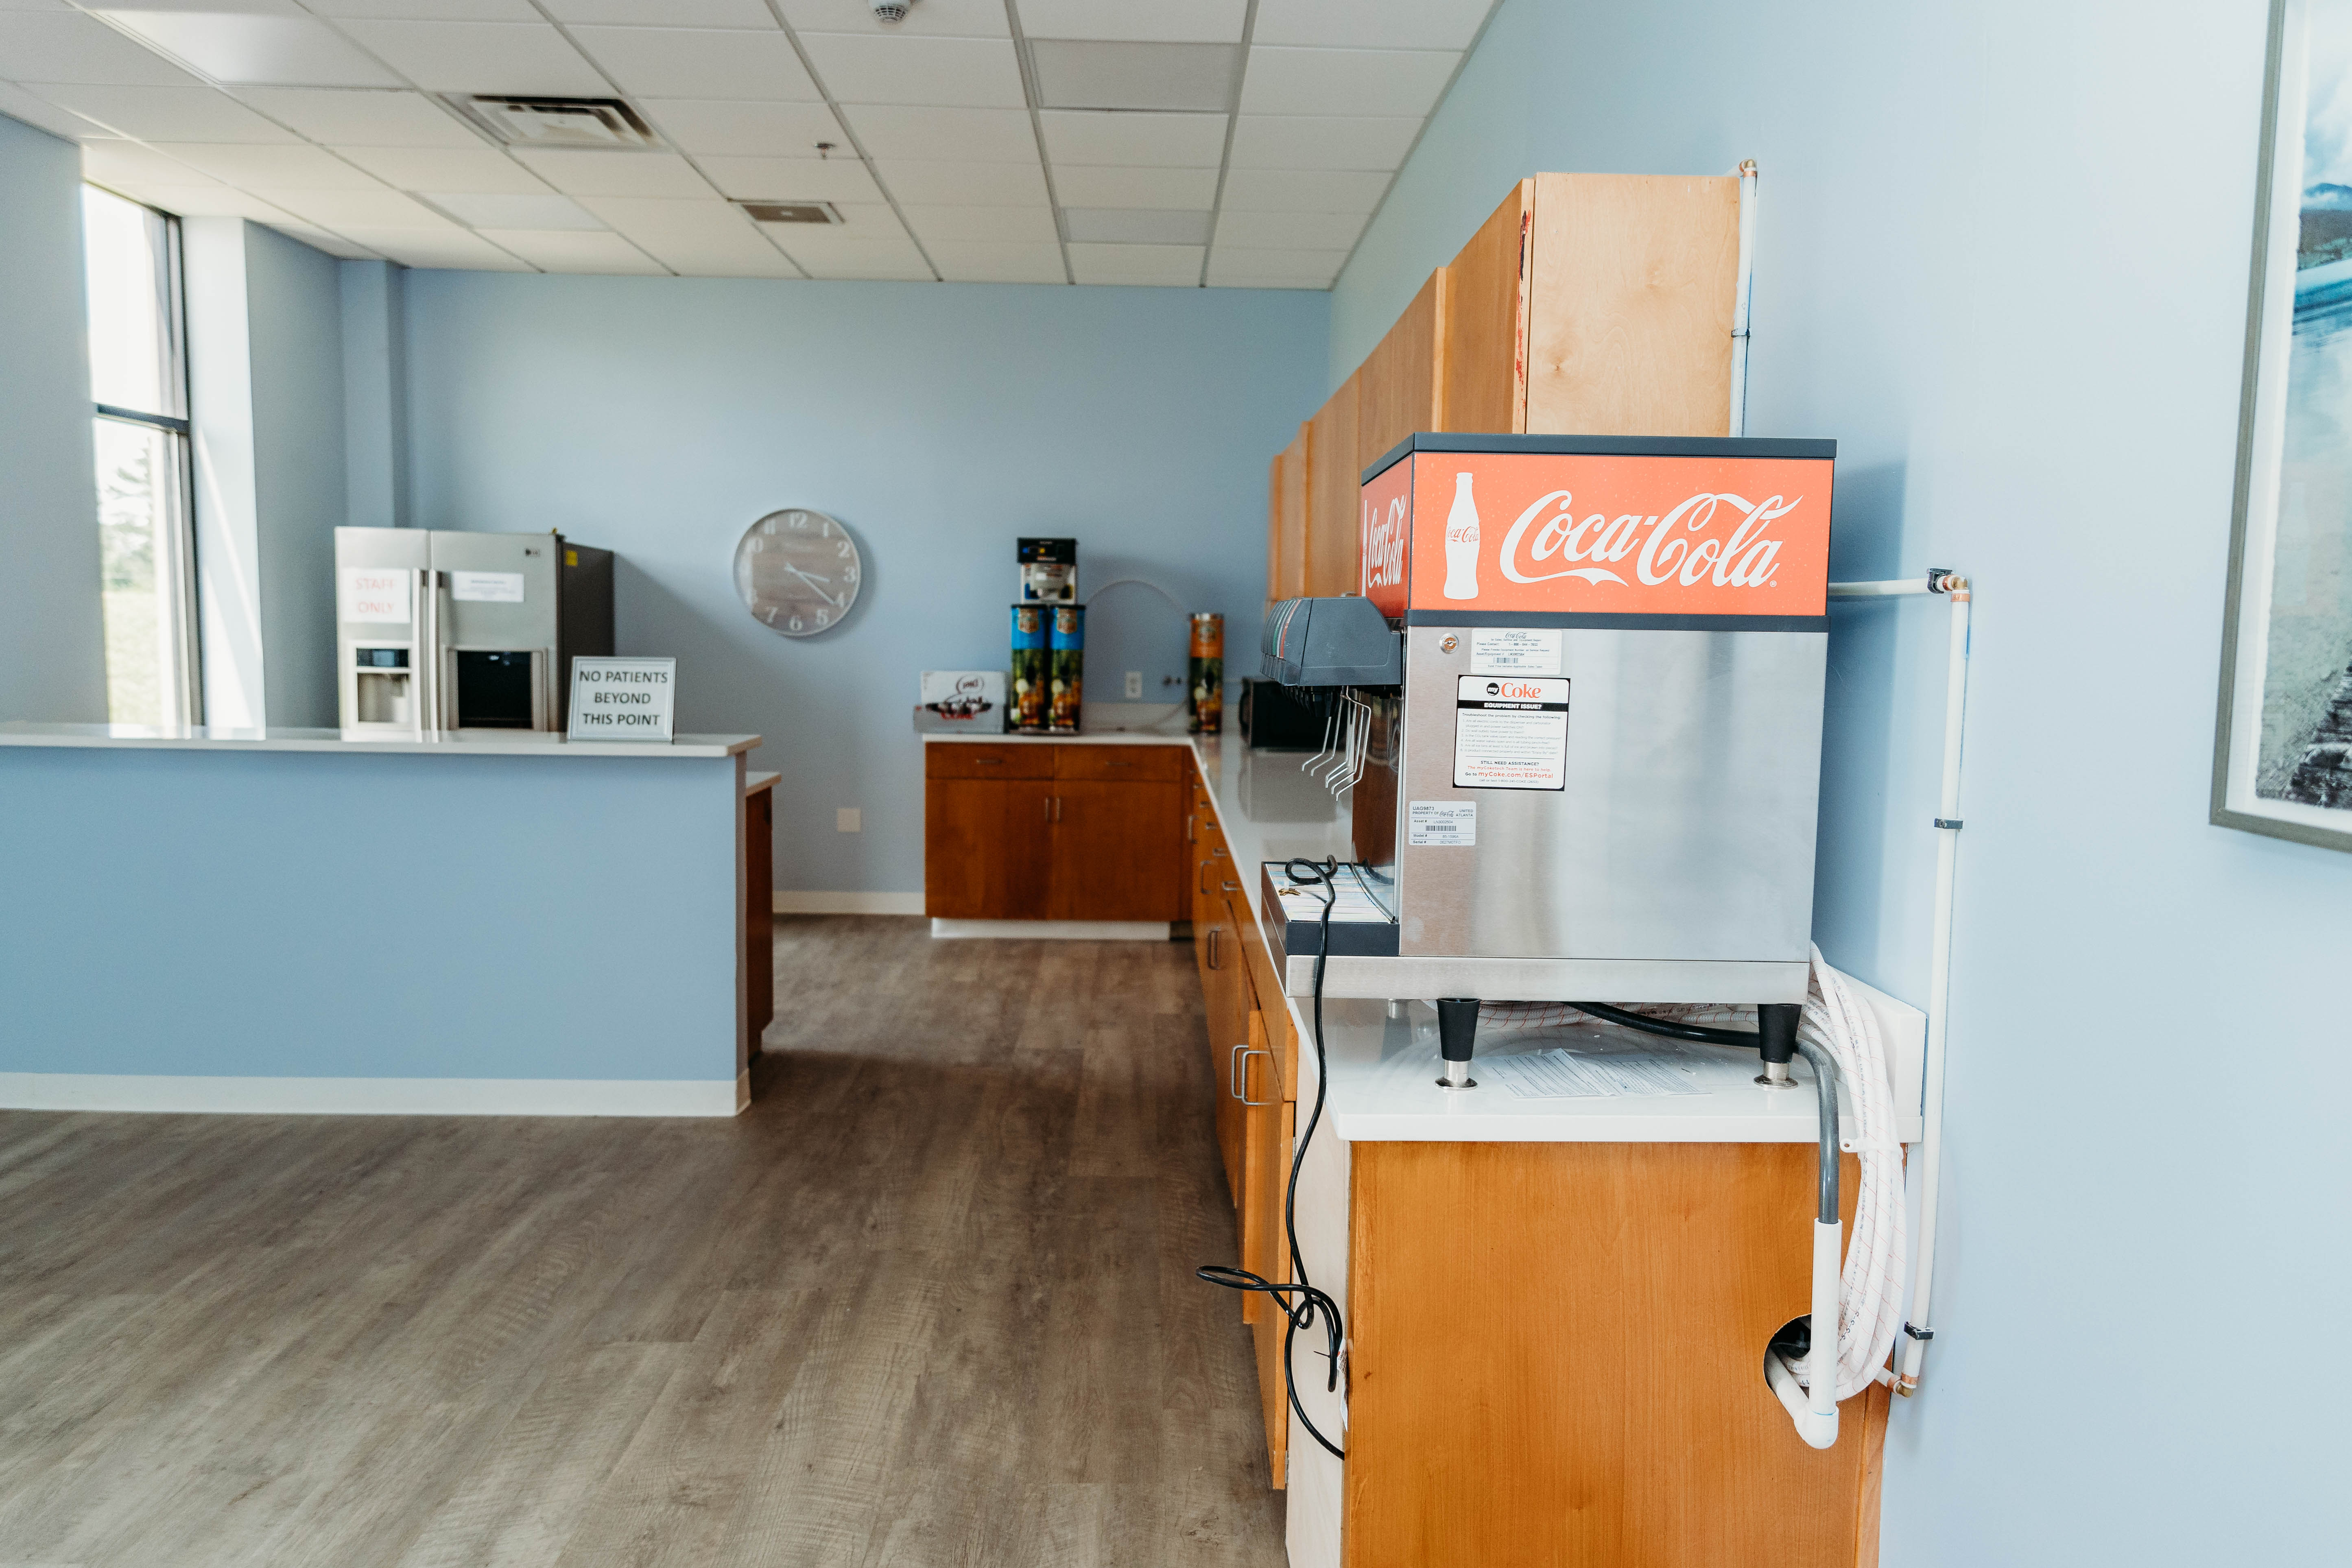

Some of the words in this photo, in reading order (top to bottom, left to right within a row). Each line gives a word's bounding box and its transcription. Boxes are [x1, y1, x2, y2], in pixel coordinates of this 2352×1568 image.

[1368, 493, 1407, 588] Coca-Cola
[1500, 489, 1804, 587] Coca-Cola
[837, 541, 850, 558] 2
[843, 566, 855, 583] 3
[355, 577, 395, 590] STAFF
[358, 601, 395, 613] ONLY
[579, 671, 601, 682] NO
[606, 671, 668, 684] PATIENTS
[1501, 682, 1541, 698] Coke
[594, 692, 651, 704] BEYOND
[583, 713, 613, 725] THIS
[618, 714, 661, 725] POINT
